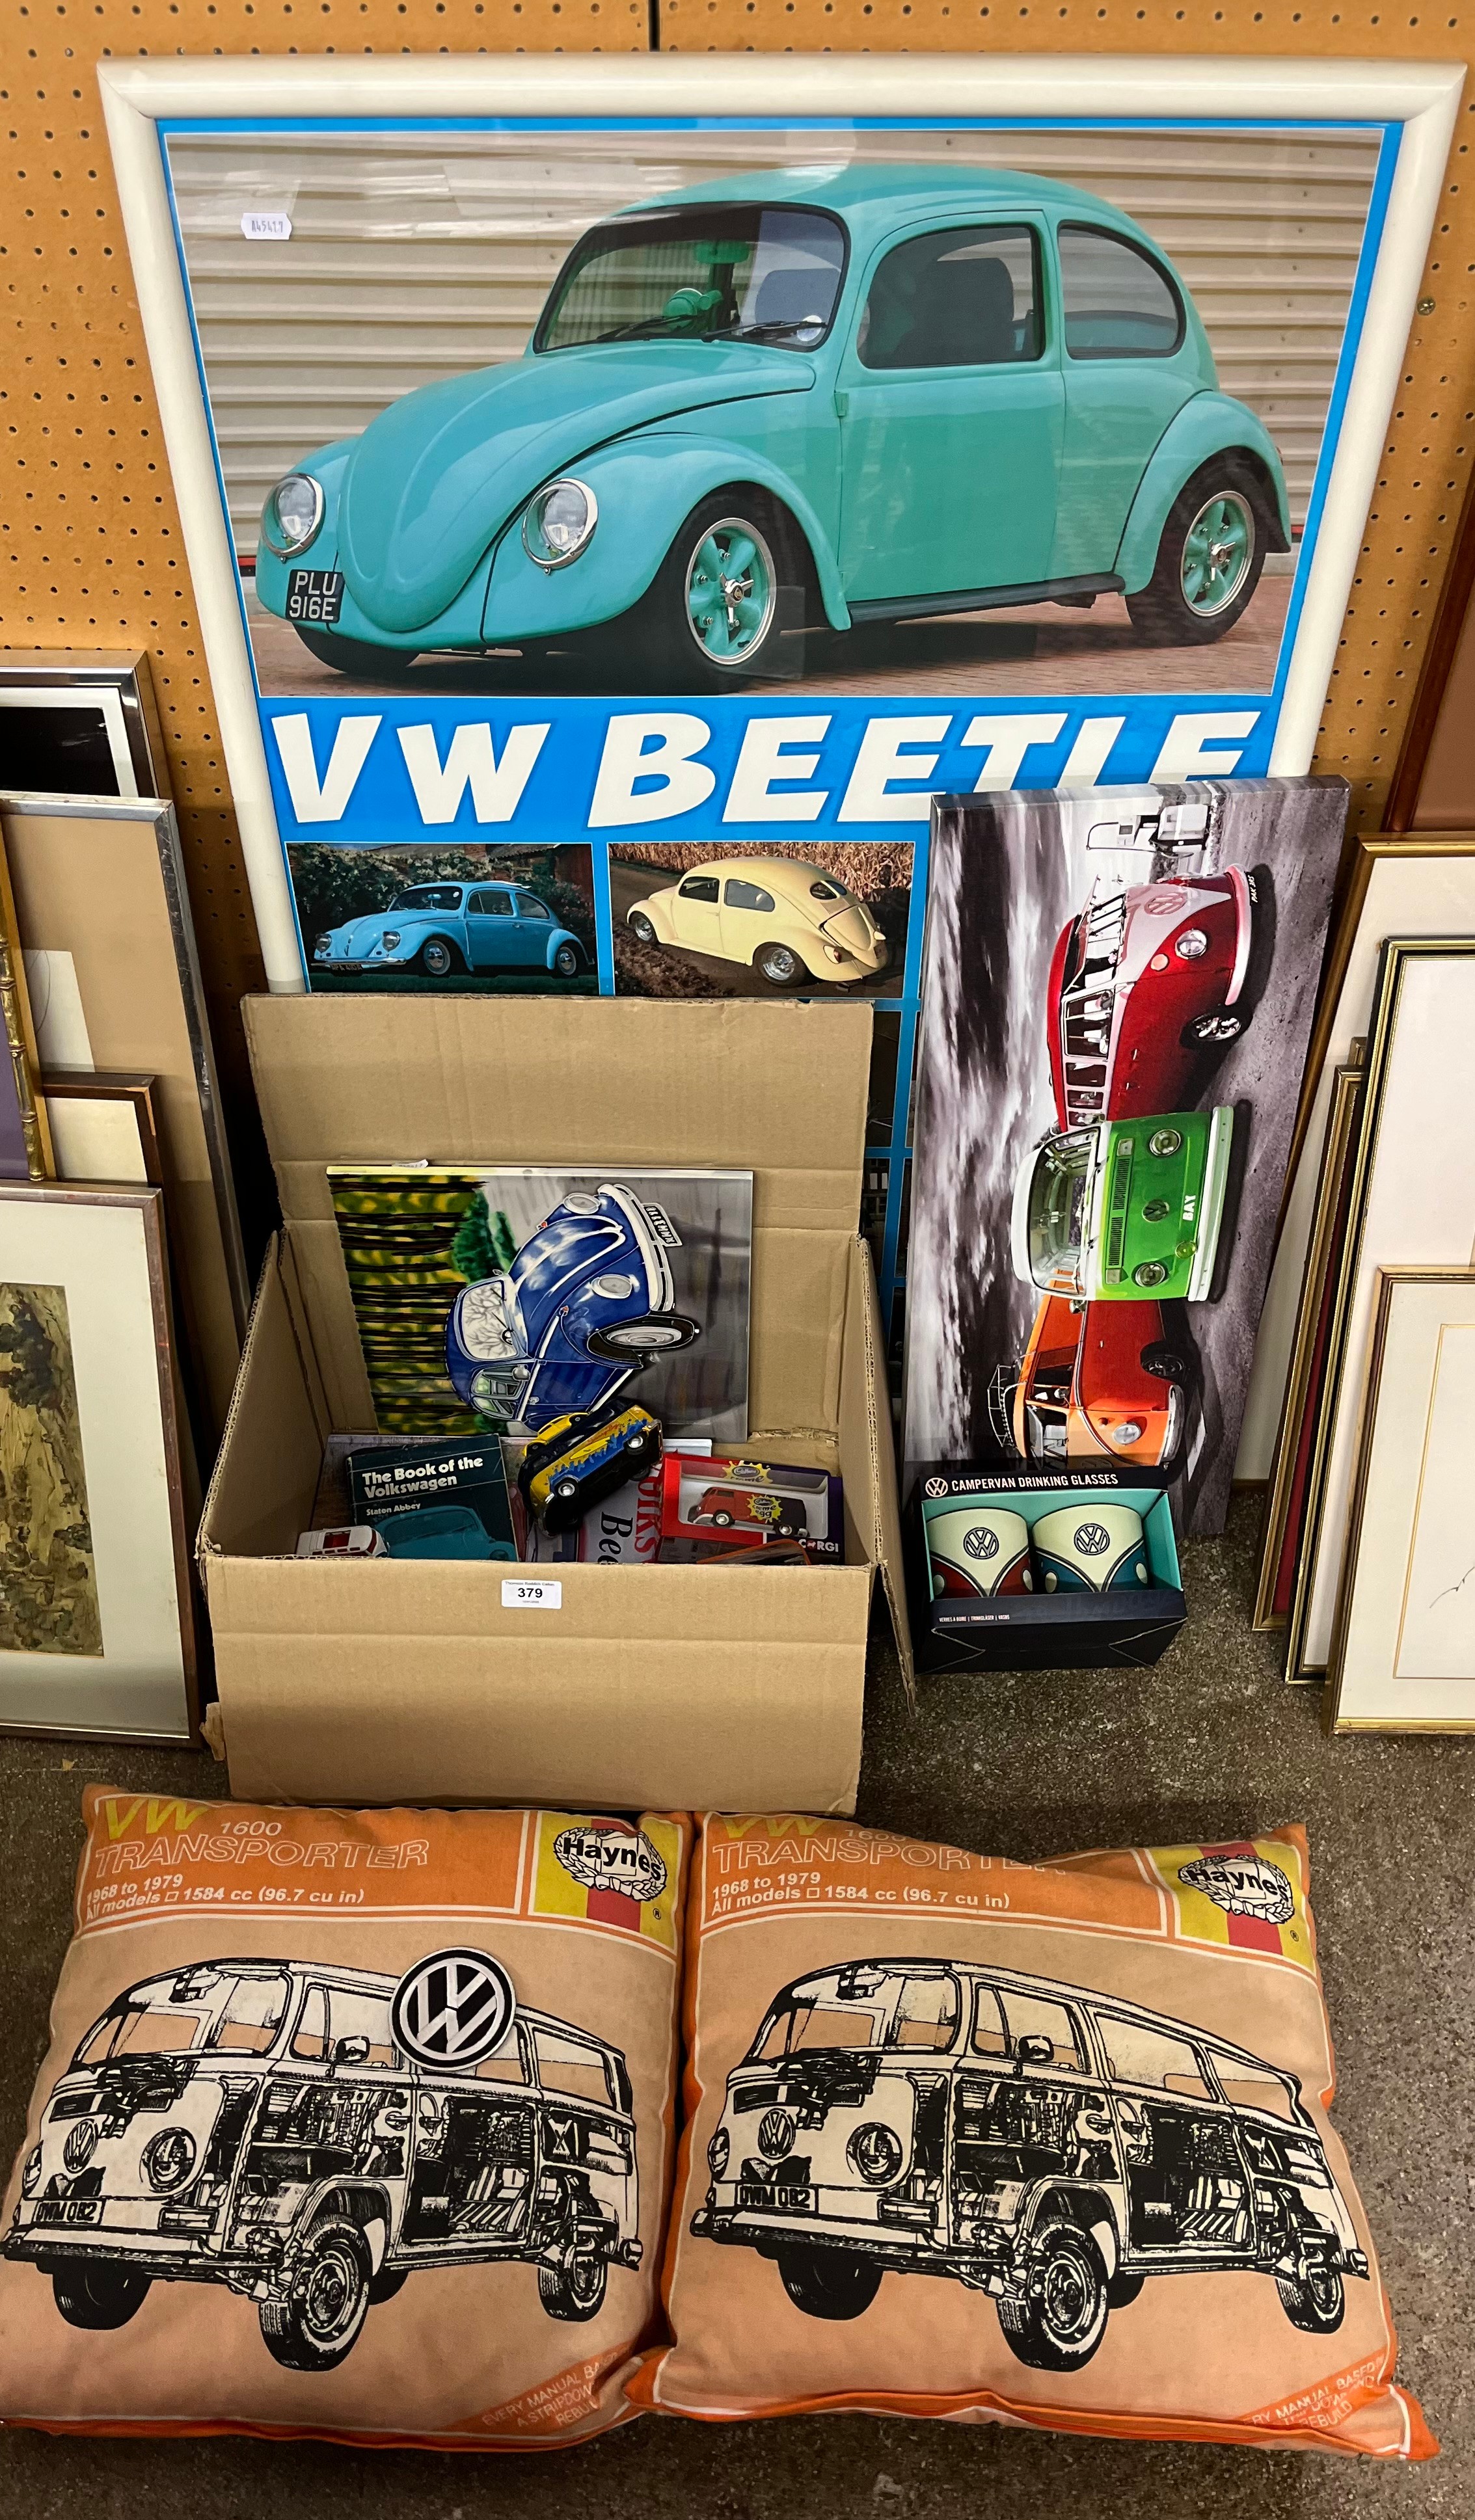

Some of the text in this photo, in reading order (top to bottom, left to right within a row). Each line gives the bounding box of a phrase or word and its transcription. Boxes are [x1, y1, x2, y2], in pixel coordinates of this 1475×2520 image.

[294, 571, 337, 596] PLU
[289, 595, 336, 620] 916E
[270, 712, 550, 824] VW
[1183, 1195, 1197, 1221] BAY
[362, 1456, 483, 1486] The Book of the
[952, 1477, 1016, 1492] CAMPERVAN
[1018, 1475, 1069, 1488] DRINKING
[1071, 1473, 1118, 1486] GLASSES
[364, 1475, 457, 1498] Volkswagen
[366, 1503, 421, 1516] Staton Abbey
[517, 1587, 543, 1598] 379
[105, 1798, 210, 1840] VW
[221, 1821, 282, 1836] 1600
[96, 1834, 429, 1879] TRANSPORTER
[563, 1837, 662, 1881] Haynes
[87, 1873, 183, 1905] 1968 to 1979
[712, 1872, 821, 1899] 1968 to 1979
[1187, 1868, 1290, 1903] Haynes
[86, 1886, 364, 1920] All models 1584 cc (96.7 cu in)
[712, 1886, 1010, 1917] All models 1584 cc (96.7 cu in)
[481, 2372, 581, 2426] EVERY MANUAL
[517, 2382, 593, 2427] A STRIPDOW
